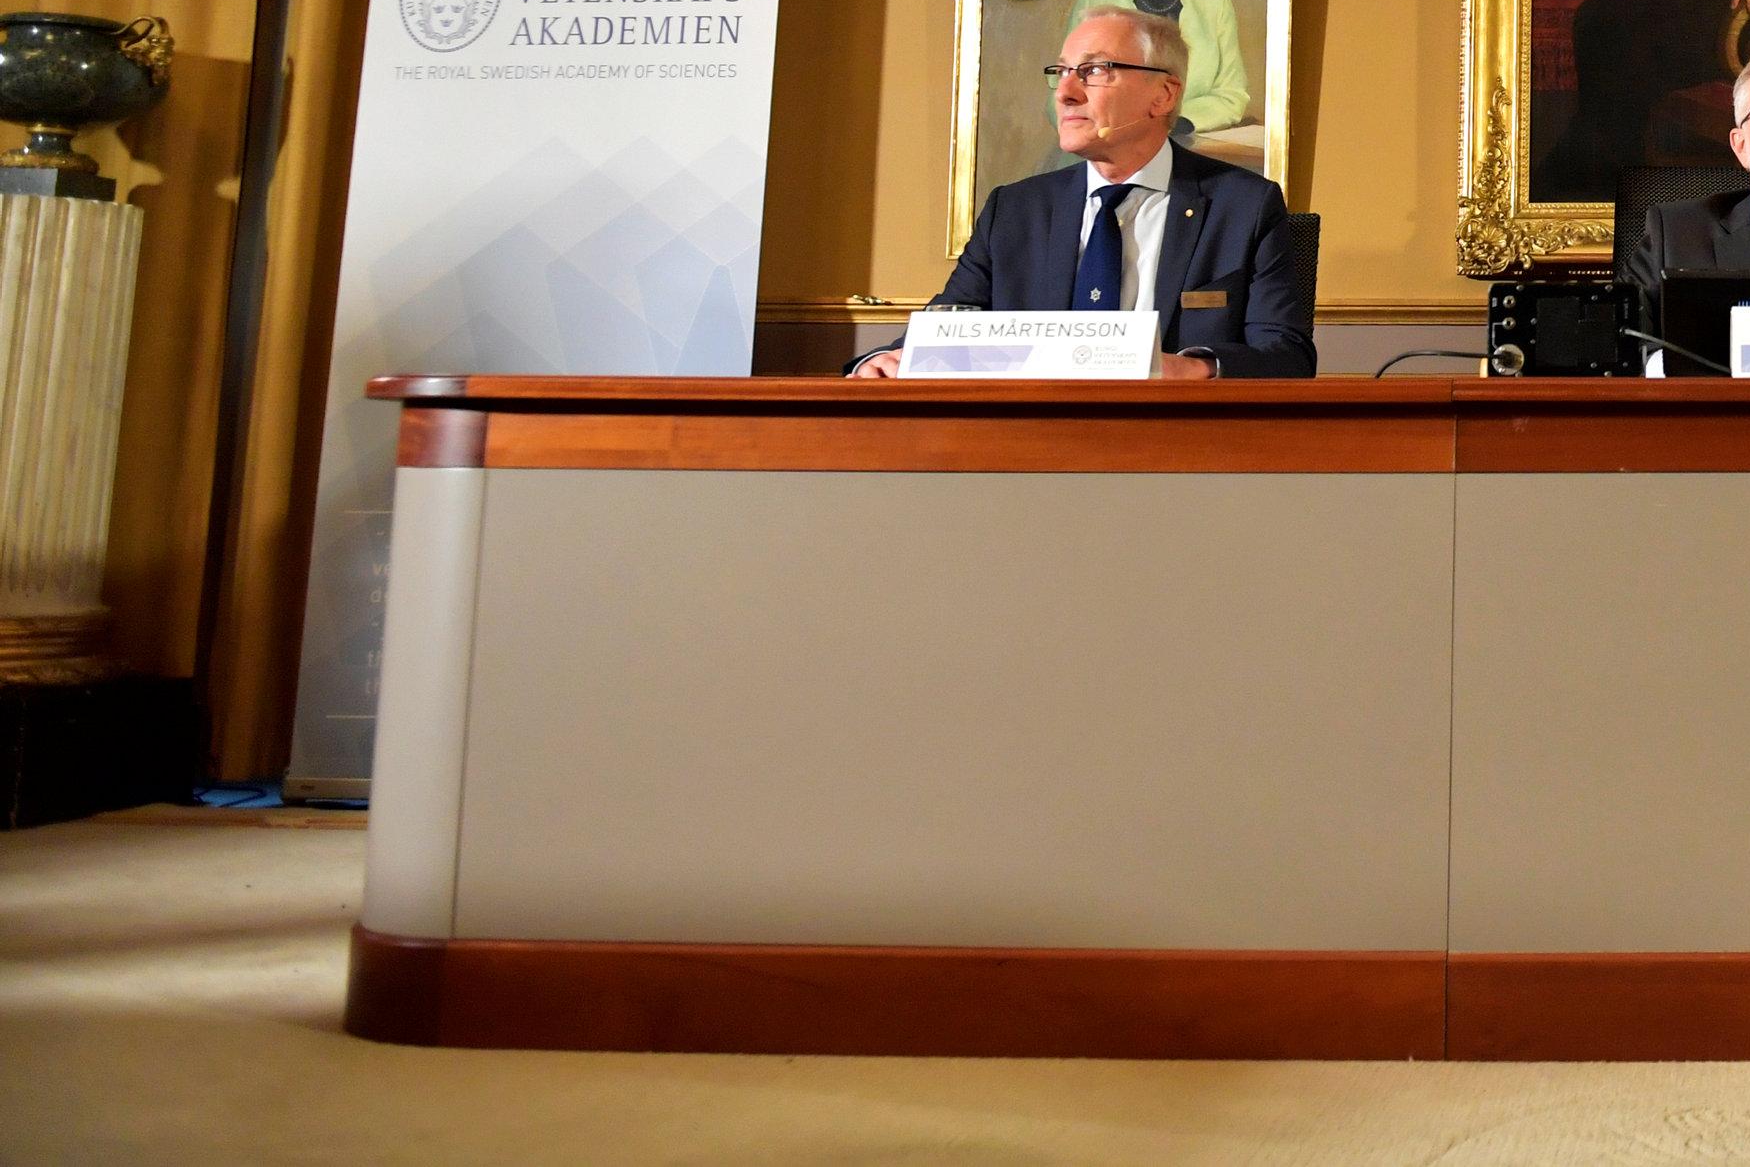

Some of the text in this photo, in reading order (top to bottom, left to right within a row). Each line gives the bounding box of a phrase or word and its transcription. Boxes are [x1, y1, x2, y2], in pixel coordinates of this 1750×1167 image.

[508, 15, 743, 46] AKADEMIEN
[394, 63, 737, 80] THE ROYAL SWEDISH ACADEMY OF SCIENCES
[936, 318, 1127, 338] NILS MÅRTENSSON
